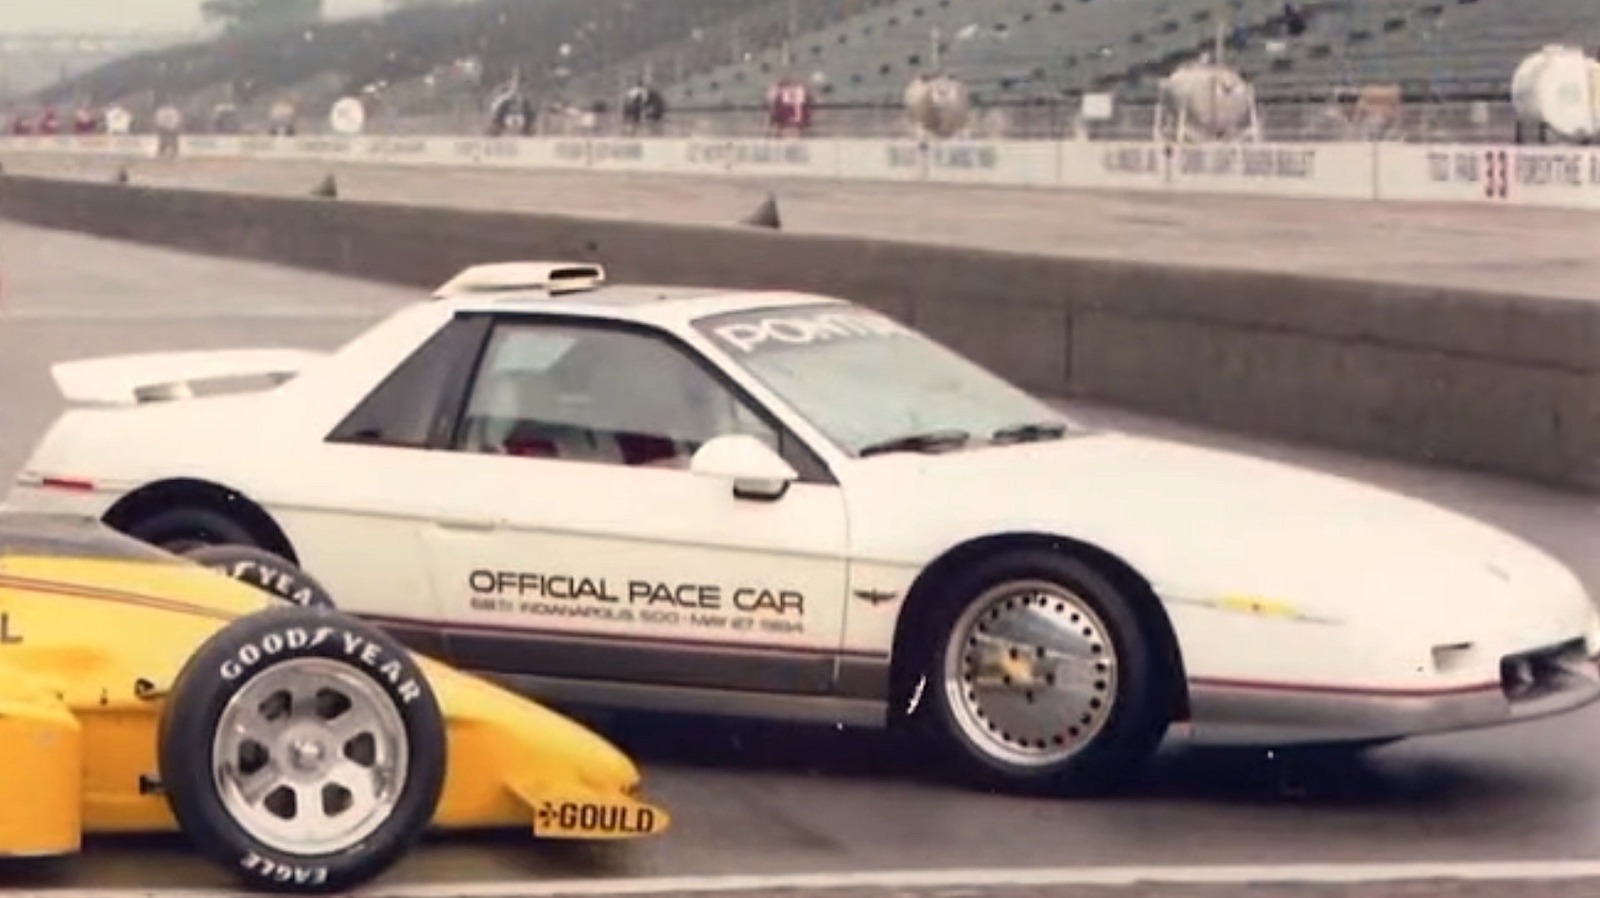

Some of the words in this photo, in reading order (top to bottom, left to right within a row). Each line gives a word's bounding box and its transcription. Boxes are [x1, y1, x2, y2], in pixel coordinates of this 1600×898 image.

[469, 570, 618, 603] OFFICIAL
[628, 580, 721, 610] PACE
[733, 588, 804, 614] CAR
[559, 801, 655, 833] GOULD
[240, 852, 328, 885] EAGLE
